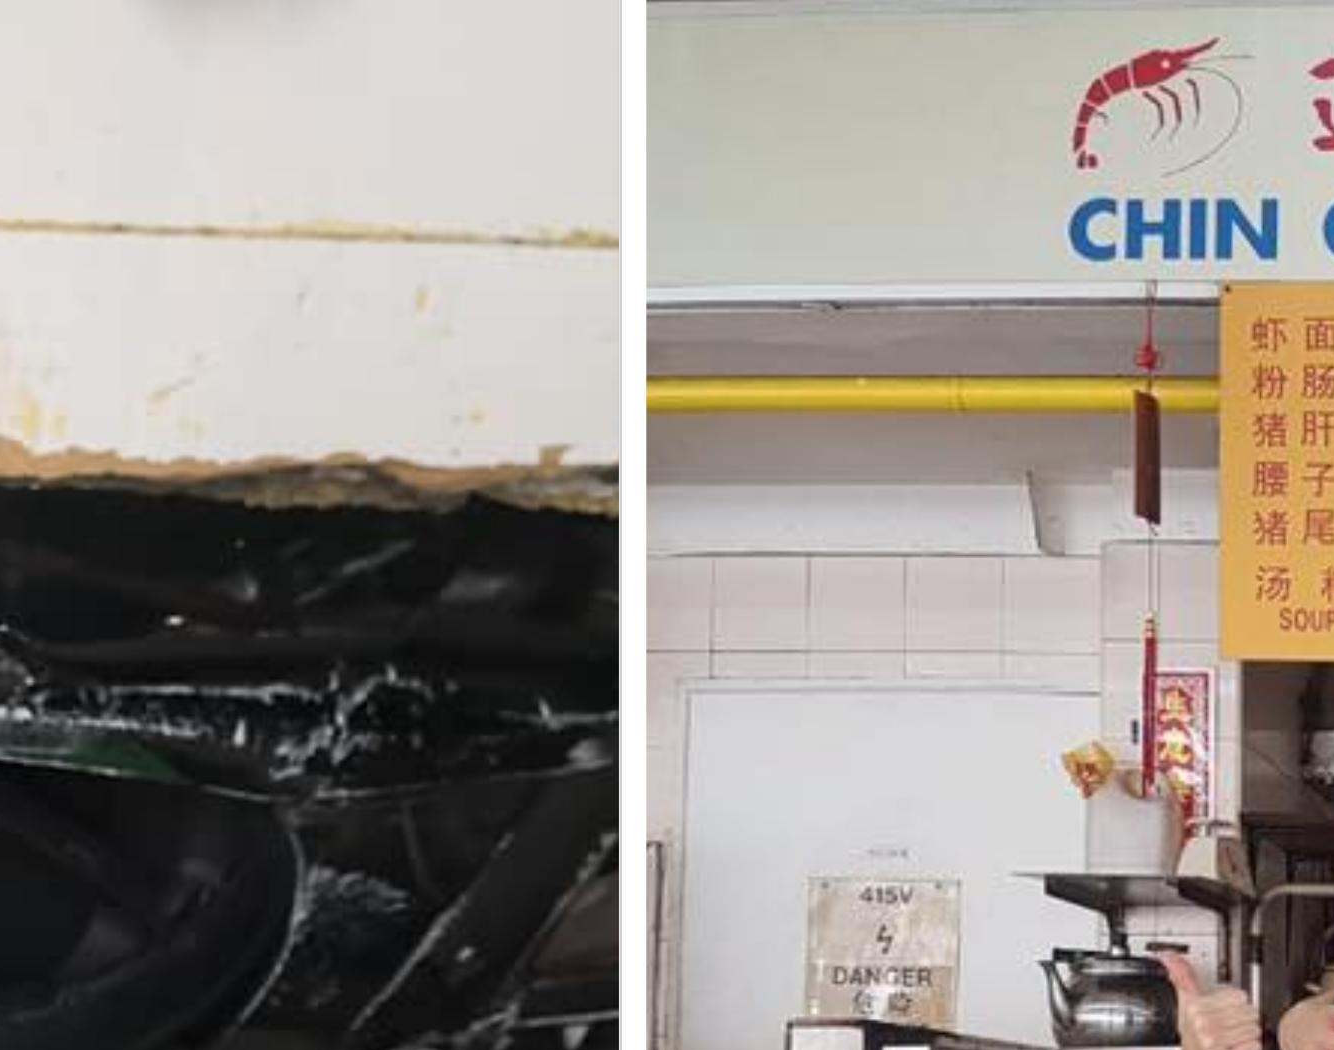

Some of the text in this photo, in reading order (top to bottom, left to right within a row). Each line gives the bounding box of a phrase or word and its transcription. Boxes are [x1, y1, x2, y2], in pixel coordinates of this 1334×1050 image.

[1068, 197, 1279, 262] CHIN
[858, 886, 914, 906] 415V
[831, 965, 934, 988] DANGER
